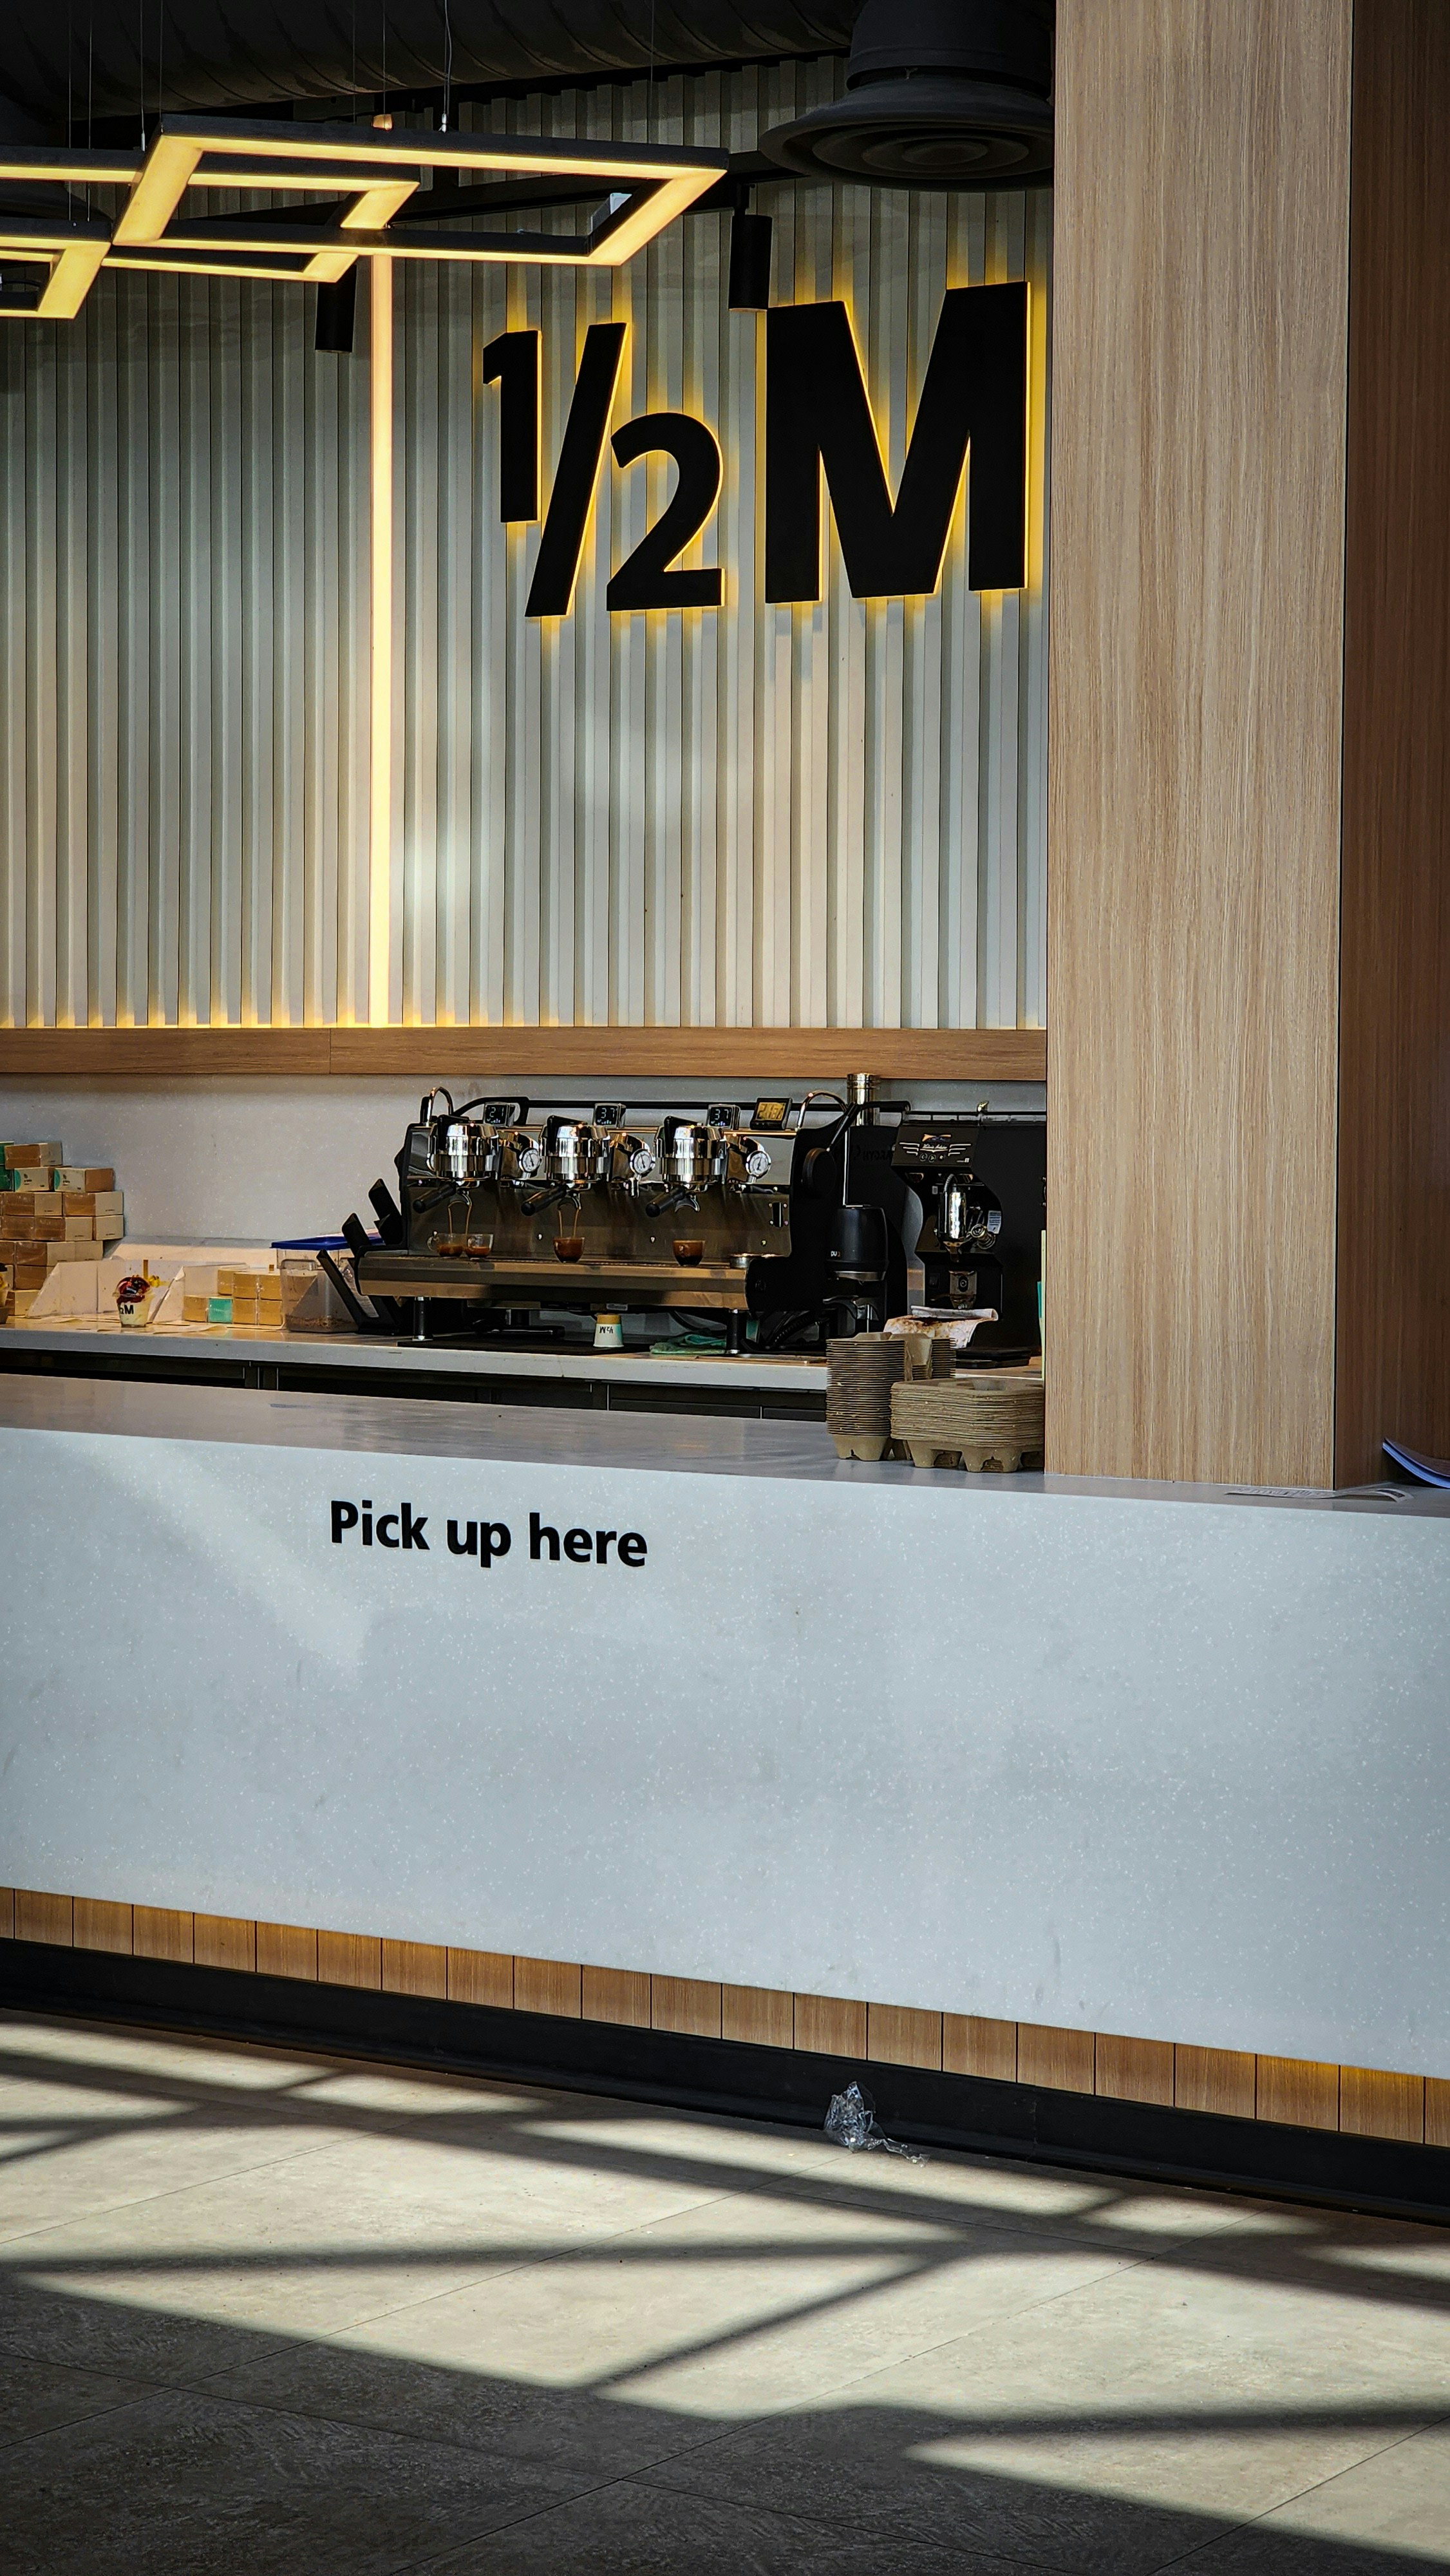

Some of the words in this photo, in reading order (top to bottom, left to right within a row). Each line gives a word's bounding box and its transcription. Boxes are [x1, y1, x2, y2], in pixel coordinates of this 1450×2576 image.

[331, 1499, 430, 1550] Pick
[447, 1519, 511, 1568] up
[529, 1512, 648, 1567] here
